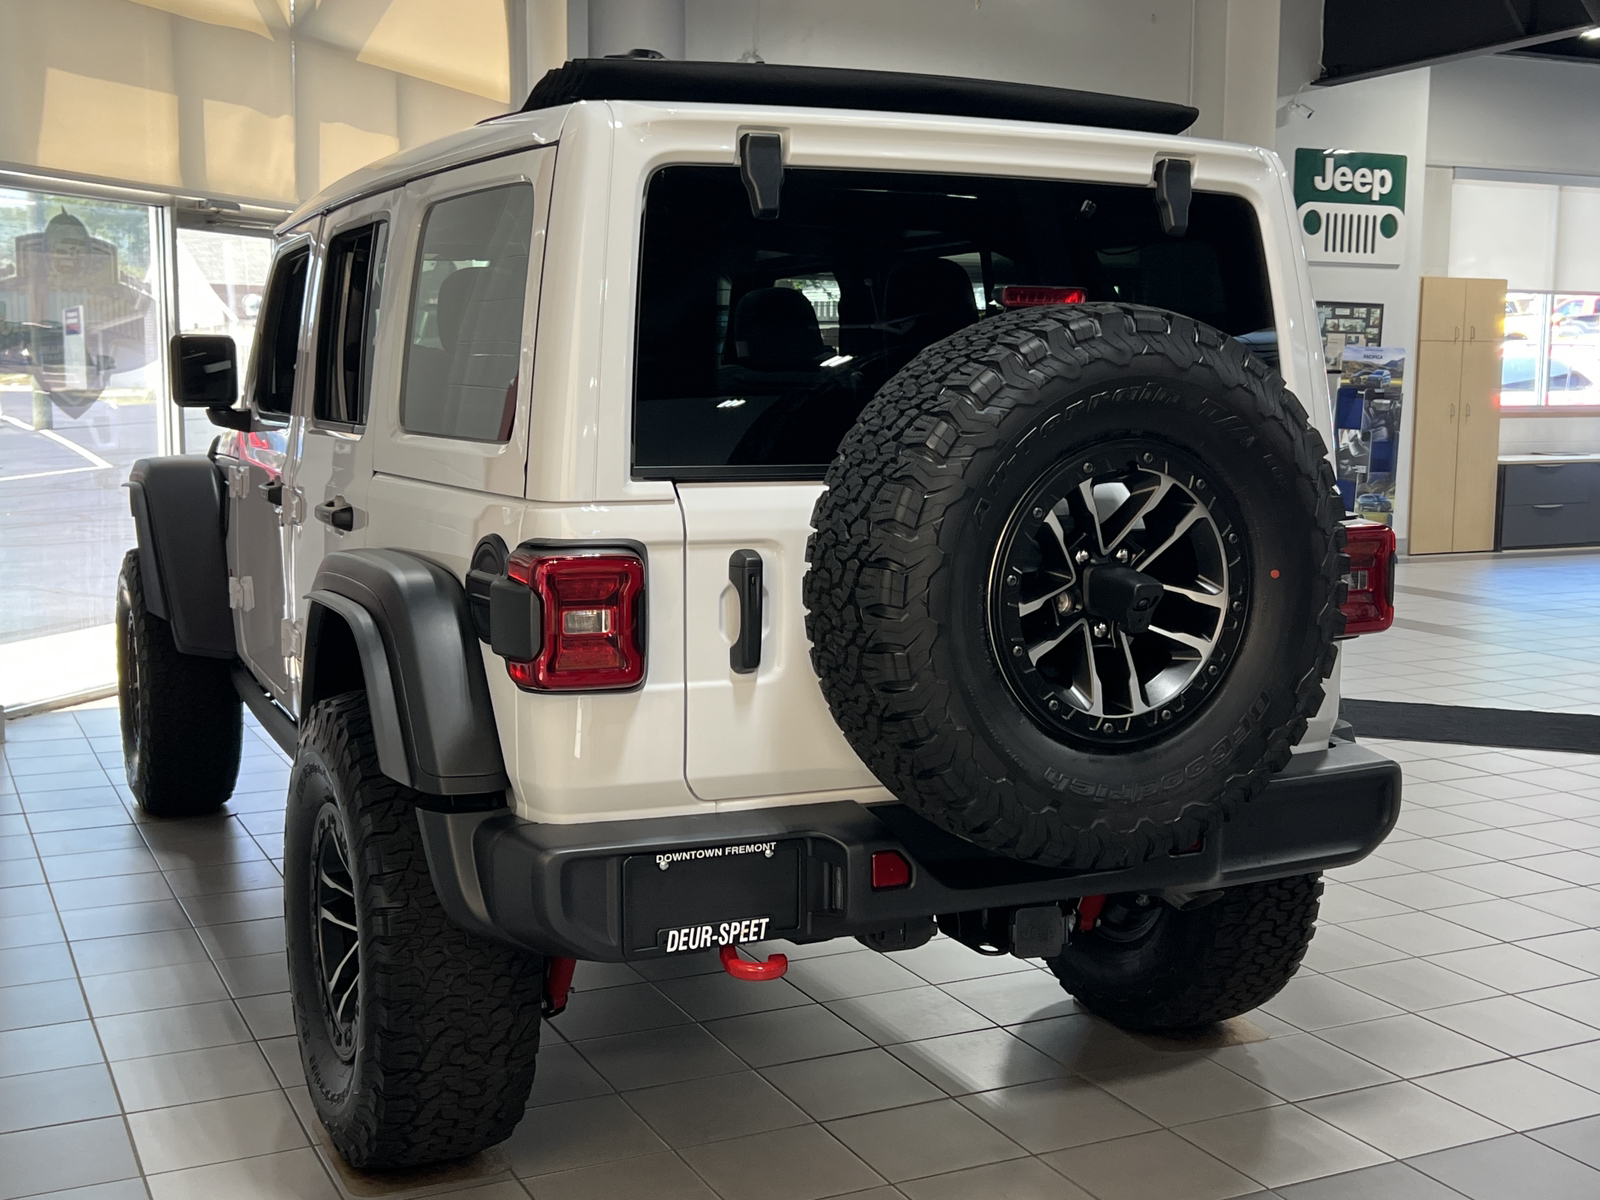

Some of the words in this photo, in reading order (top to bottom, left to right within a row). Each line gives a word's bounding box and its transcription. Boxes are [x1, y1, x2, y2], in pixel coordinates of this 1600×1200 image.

[1313, 157, 1393, 202] Jeep
[655, 848, 723, 863] DOWNTOWN
[725, 842, 777, 856] FREMONT
[666, 917, 770, 953] DEUR-SPEET
